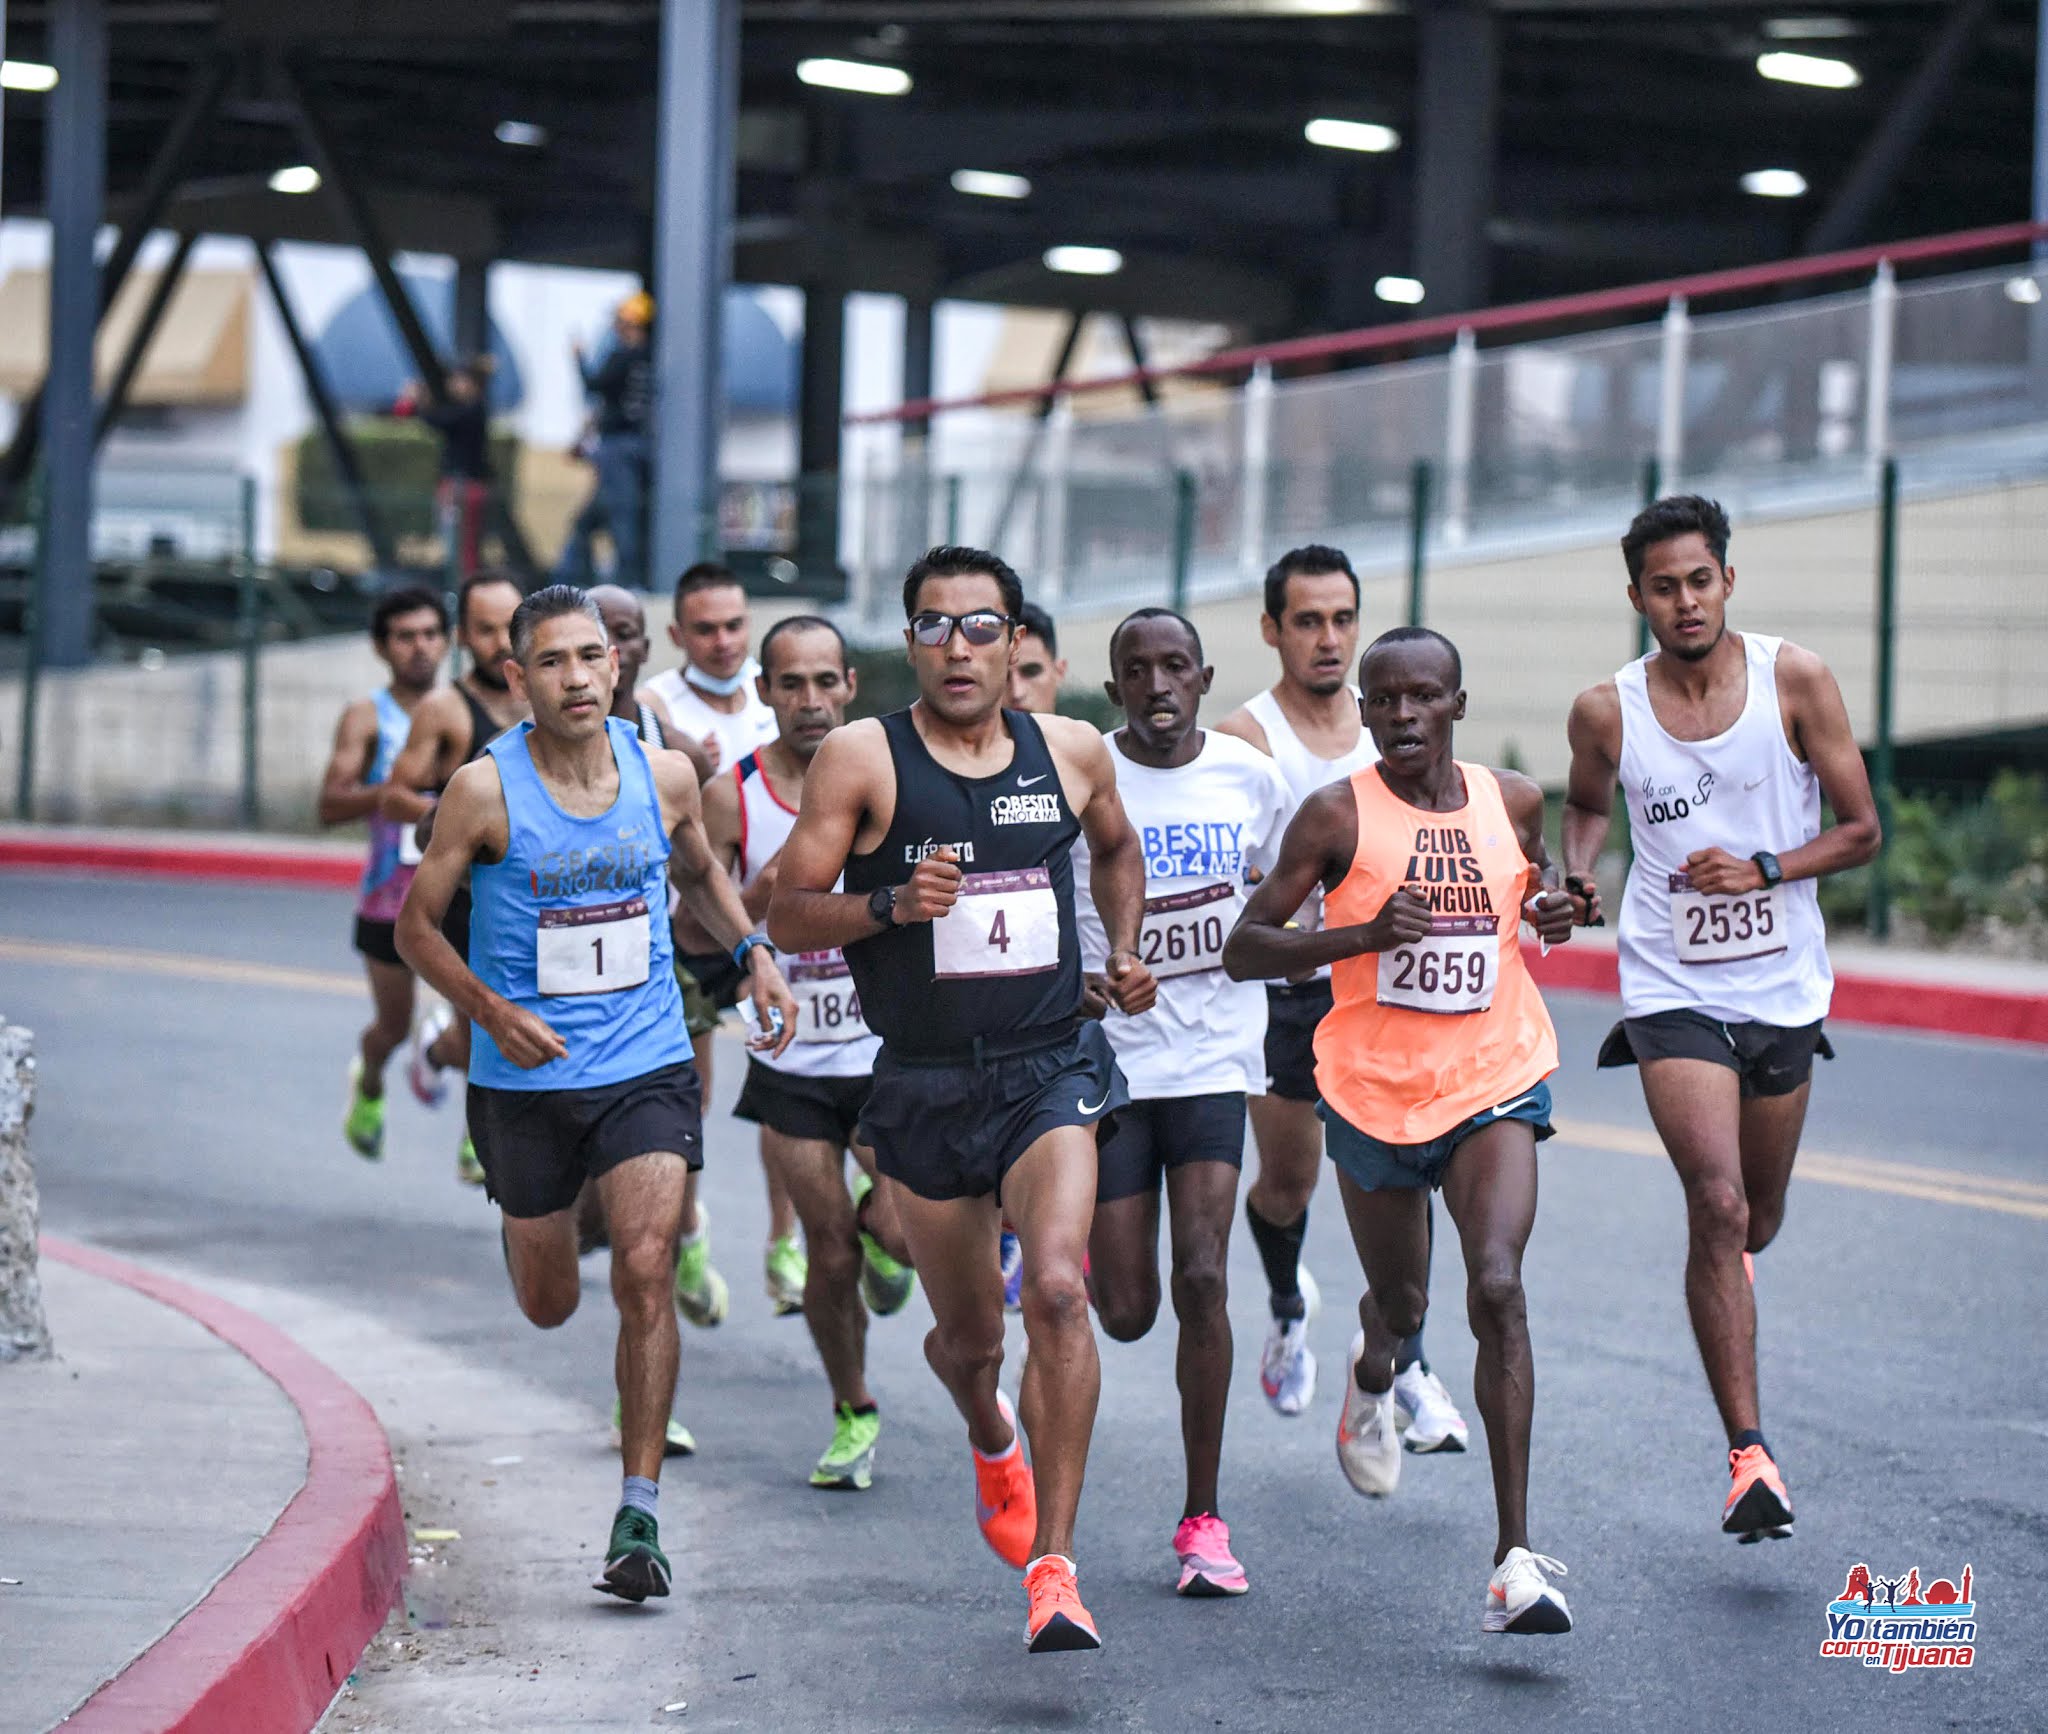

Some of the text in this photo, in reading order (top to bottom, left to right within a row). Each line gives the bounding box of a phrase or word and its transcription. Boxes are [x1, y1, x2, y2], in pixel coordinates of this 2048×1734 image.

[995, 793, 1059, 813] OBESITY
[1658, 784, 1677, 797] con
[1008, 809, 1059, 823] NOT 4 ME
[1643, 798, 1690, 825] LOLO
[904, 837, 975, 864] EJÉRTO
[1143, 822, 1243, 857] BESITY
[1415, 828, 1472, 854] CLUB
[1188, 854, 1205, 876] 4
[1209, 852, 1239, 875] ME
[1404, 856, 1484, 883] LUIS
[1398, 885, 1493, 913] NGUIA
[988, 909, 1010, 954] 4
[1686, 897, 1774, 946] 2535
[1142, 915, 1223, 966] 2610
[591, 937, 603, 976] 1
[1392, 951, 1485, 994] 2659
